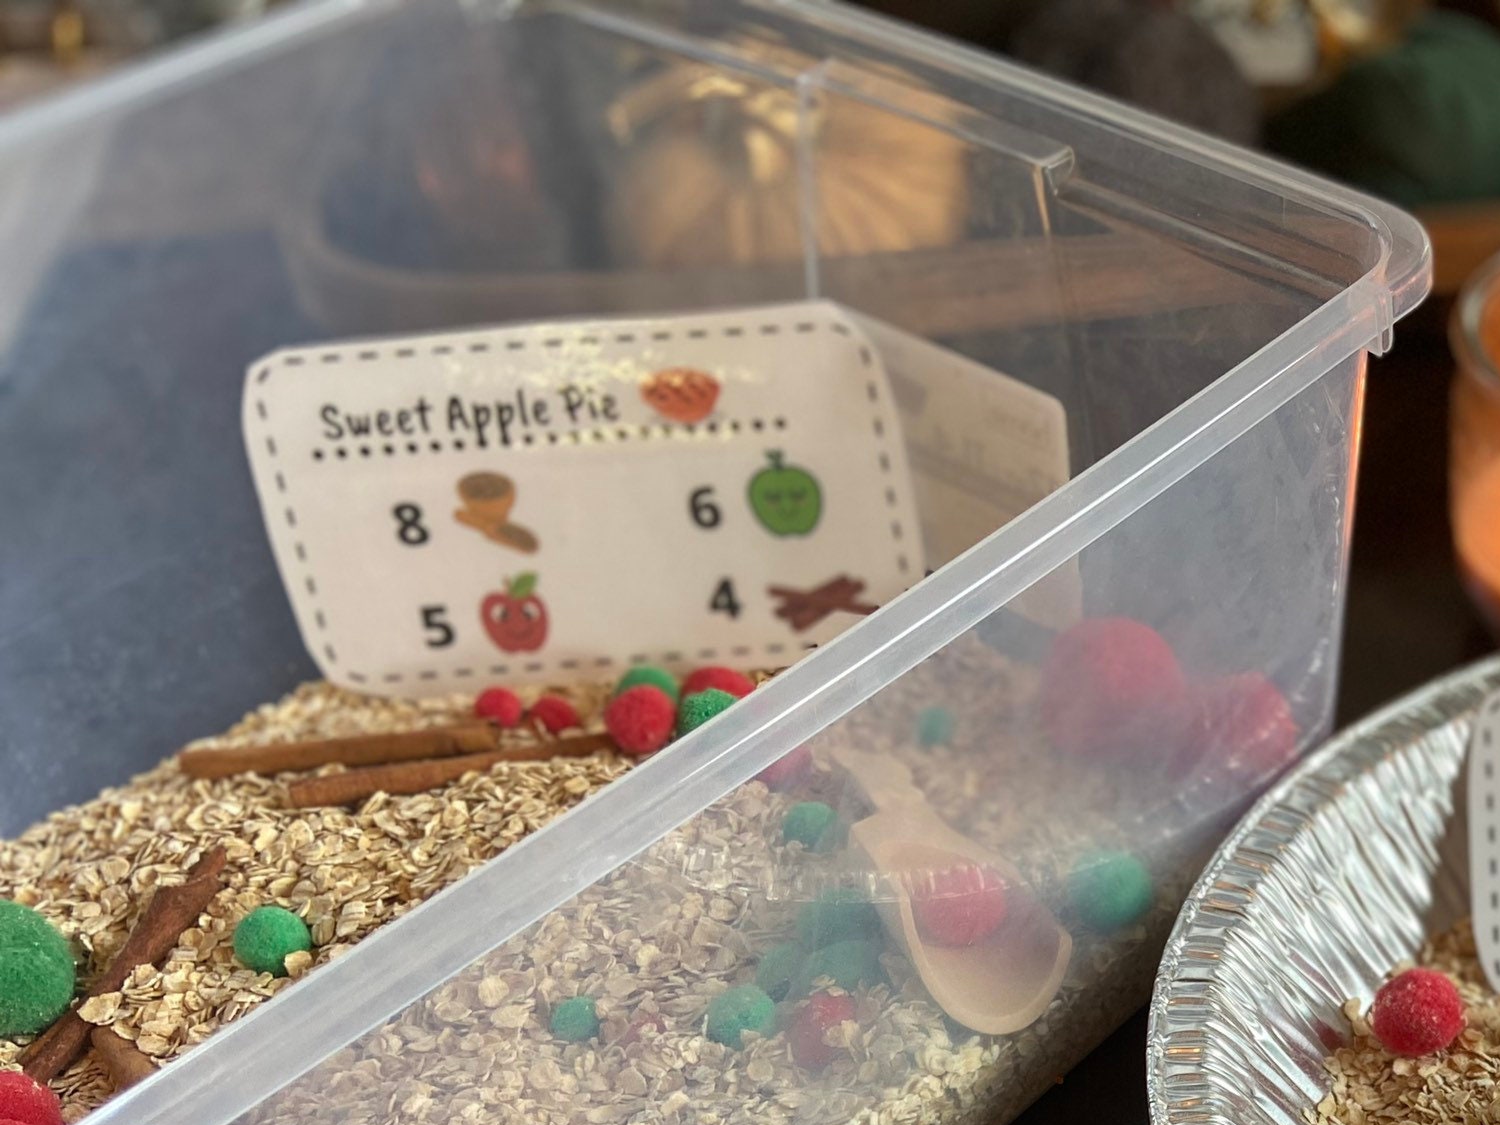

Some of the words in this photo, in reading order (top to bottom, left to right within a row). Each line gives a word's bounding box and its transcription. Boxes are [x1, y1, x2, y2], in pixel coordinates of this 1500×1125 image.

[320, 397, 432, 440] Sweet
[447, 387, 551, 446] Apple
[559, 384, 621, 422] Pie
[392, 503, 430, 547] 8
[688, 486, 722, 530] 6
[709, 578, 741, 619] 4
[421, 605, 455, 650] 5
